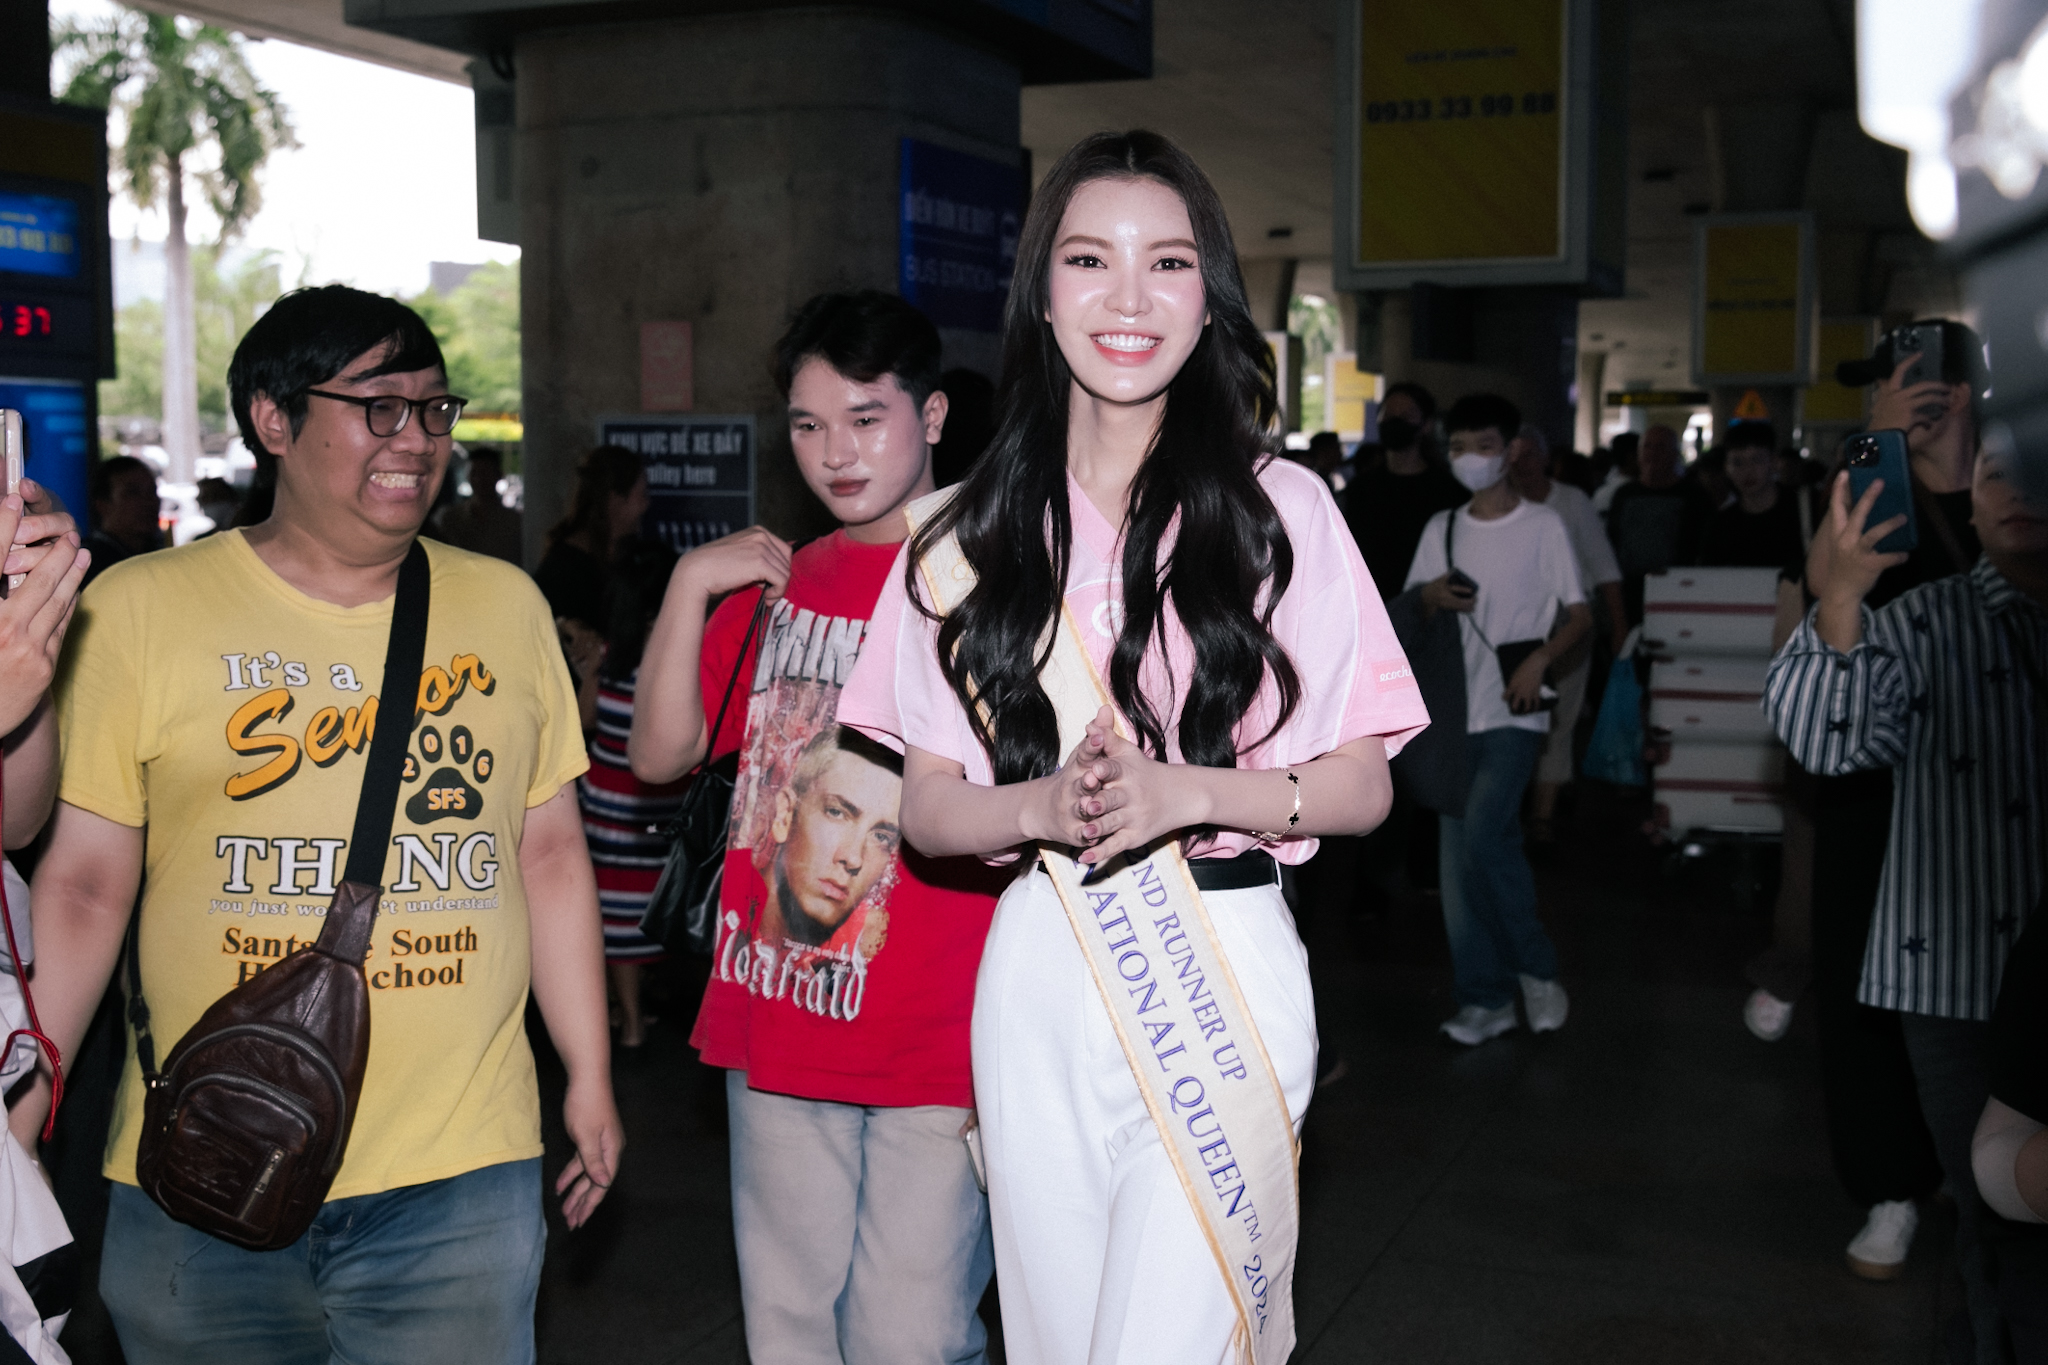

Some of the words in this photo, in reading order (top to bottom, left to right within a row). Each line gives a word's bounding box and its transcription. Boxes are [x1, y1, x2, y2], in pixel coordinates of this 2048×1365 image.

[221, 651, 310, 691] It's
[329, 663, 363, 692] a
[224, 652, 496, 802] Senor
[427, 787, 466, 811] SFS
[216, 831, 499, 896] THNG
[208, 897, 243, 915] you
[246, 899, 289, 918] just
[406, 894, 499, 913] understand
[390, 925, 478, 959] South
[364, 957, 465, 991] chool
[1153, 911, 1227, 1042] RUNNER
[1212, 1040, 1247, 1081] UP
